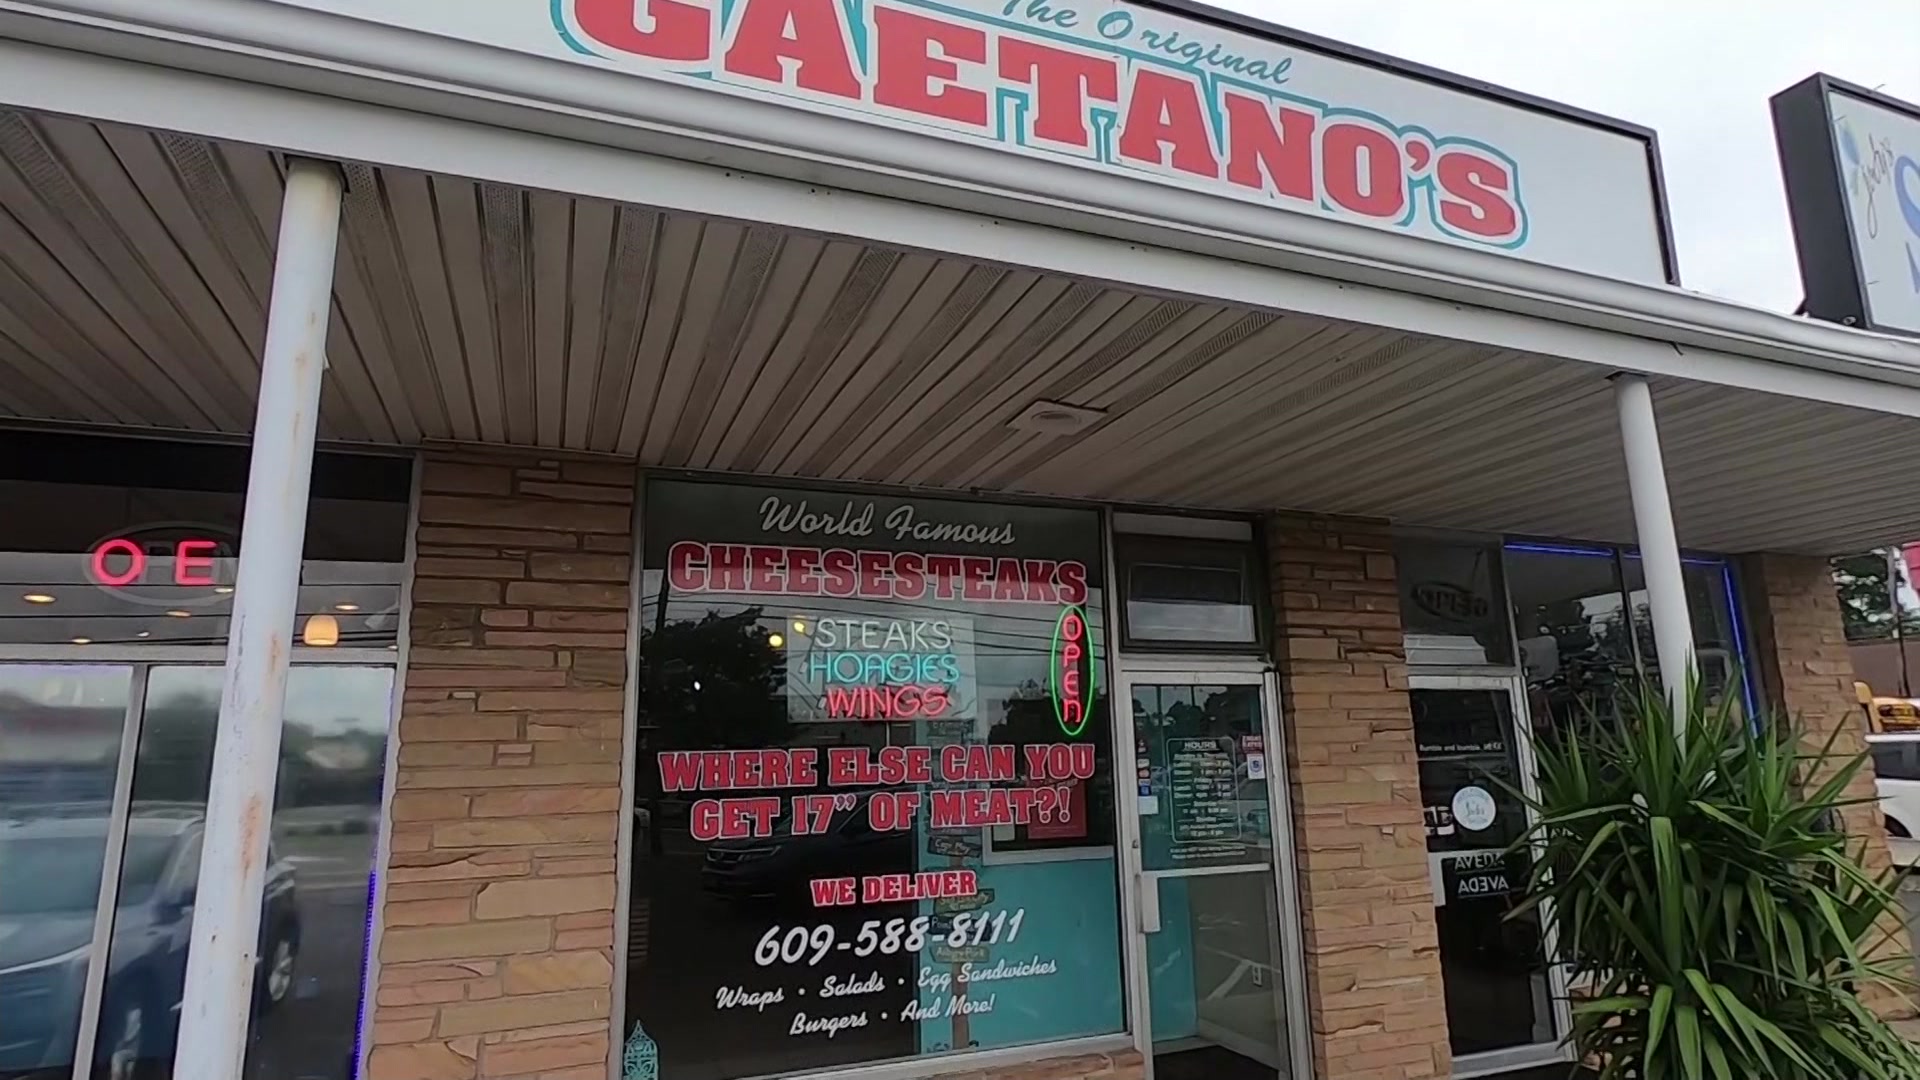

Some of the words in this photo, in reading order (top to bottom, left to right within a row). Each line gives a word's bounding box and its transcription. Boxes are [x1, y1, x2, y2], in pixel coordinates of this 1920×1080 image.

[1097, 10, 1295, 85] Original
[758, 496, 873, 536] World
[884, 504, 1016, 545] Famous
[668, 541, 1088, 605] CHEESESTEAKS
[814, 617, 952, 650] STEAKS
[806, 652, 961, 684] HOAGIES
[825, 686, 949, 717] WINGS
[657, 748, 818, 792] WHERE
[827, 746, 932, 787] ELSE
[940, 744, 1016, 782] CAN
[1023, 742, 1096, 780] YOU
[1184, 741, 1217, 750] HOURS
[690, 797, 781, 840] GET
[868, 792, 921, 830] OF
[930, 786, 1072, 828] MEAT?!
[811, 877, 856, 906] WE
[862, 870, 978, 903] DELIVER
[754, 908, 1026, 967] 609-588-8111
[716, 985, 785, 1012] Wraps
[819, 972, 886, 999] Salads
[917, 967, 953, 990] Egg
[956, 956, 1057, 984] Sandwiches
[789, 1010, 869, 1039] Burgers
[900, 998, 941, 1022] And
[945, 993, 995, 1018] More!
